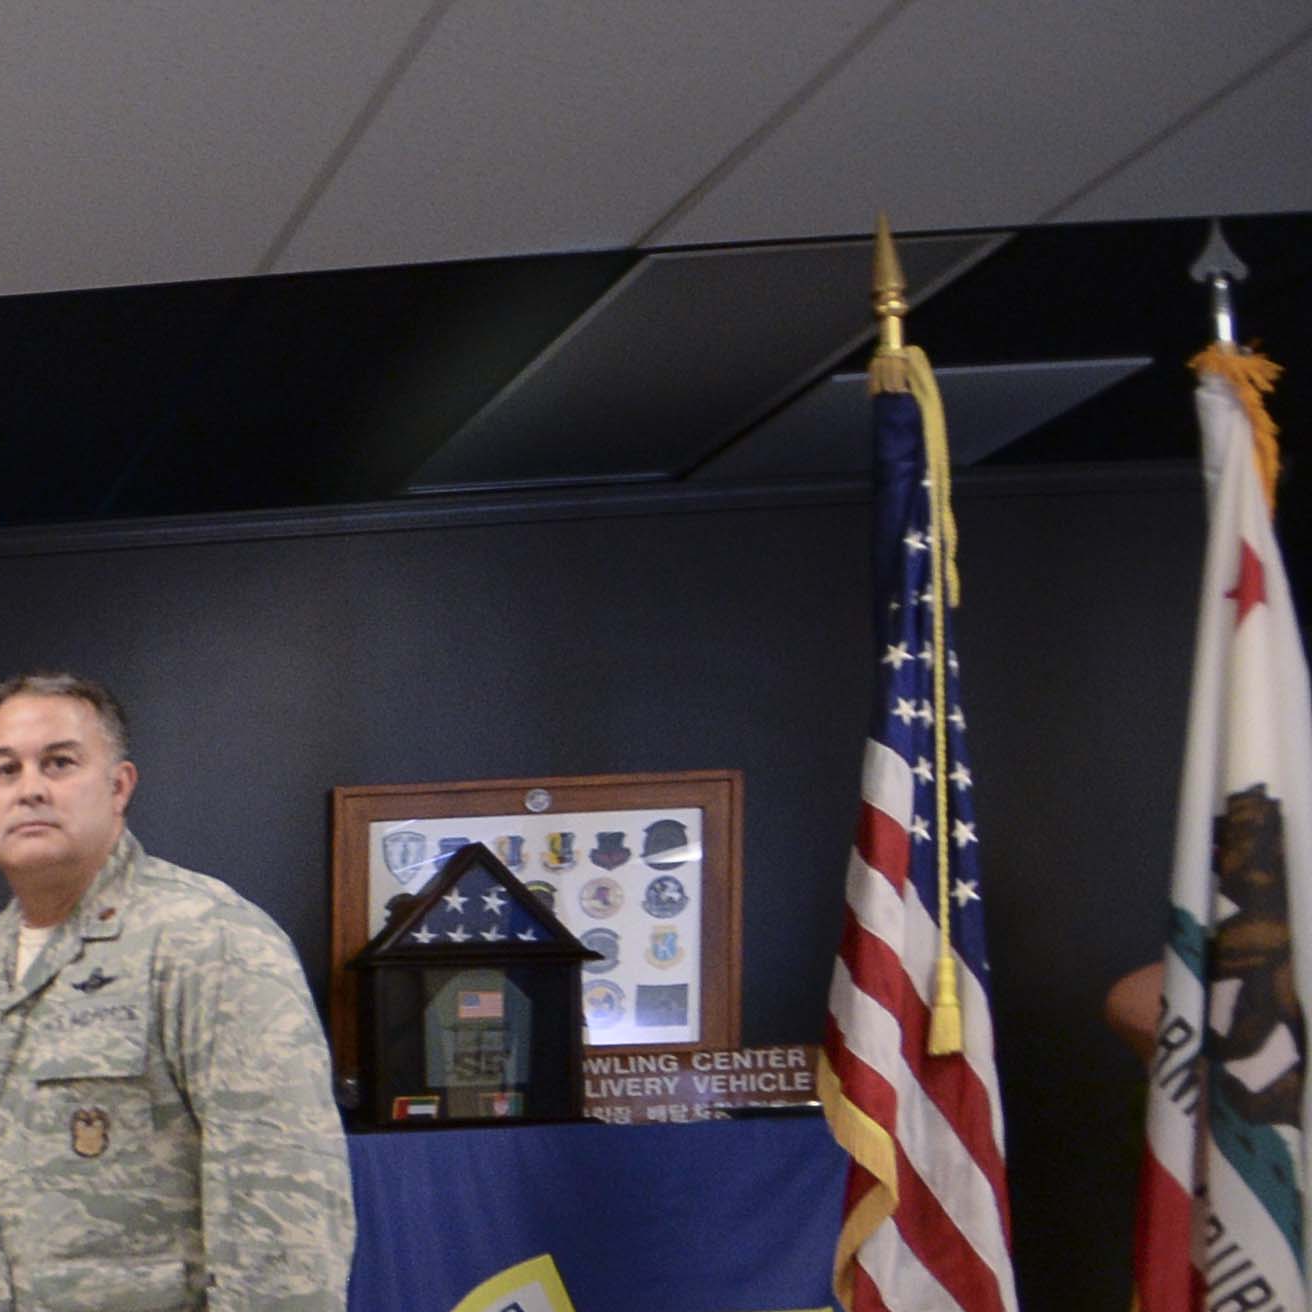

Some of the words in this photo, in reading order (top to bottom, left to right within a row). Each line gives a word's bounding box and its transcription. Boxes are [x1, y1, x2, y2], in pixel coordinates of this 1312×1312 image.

[583, 1054, 679, 1074] WLING
[691, 1048, 807, 1072] CENTER
[584, 1076, 679, 1098] LIVERY
[691, 1071, 812, 1094] VEHICLE
